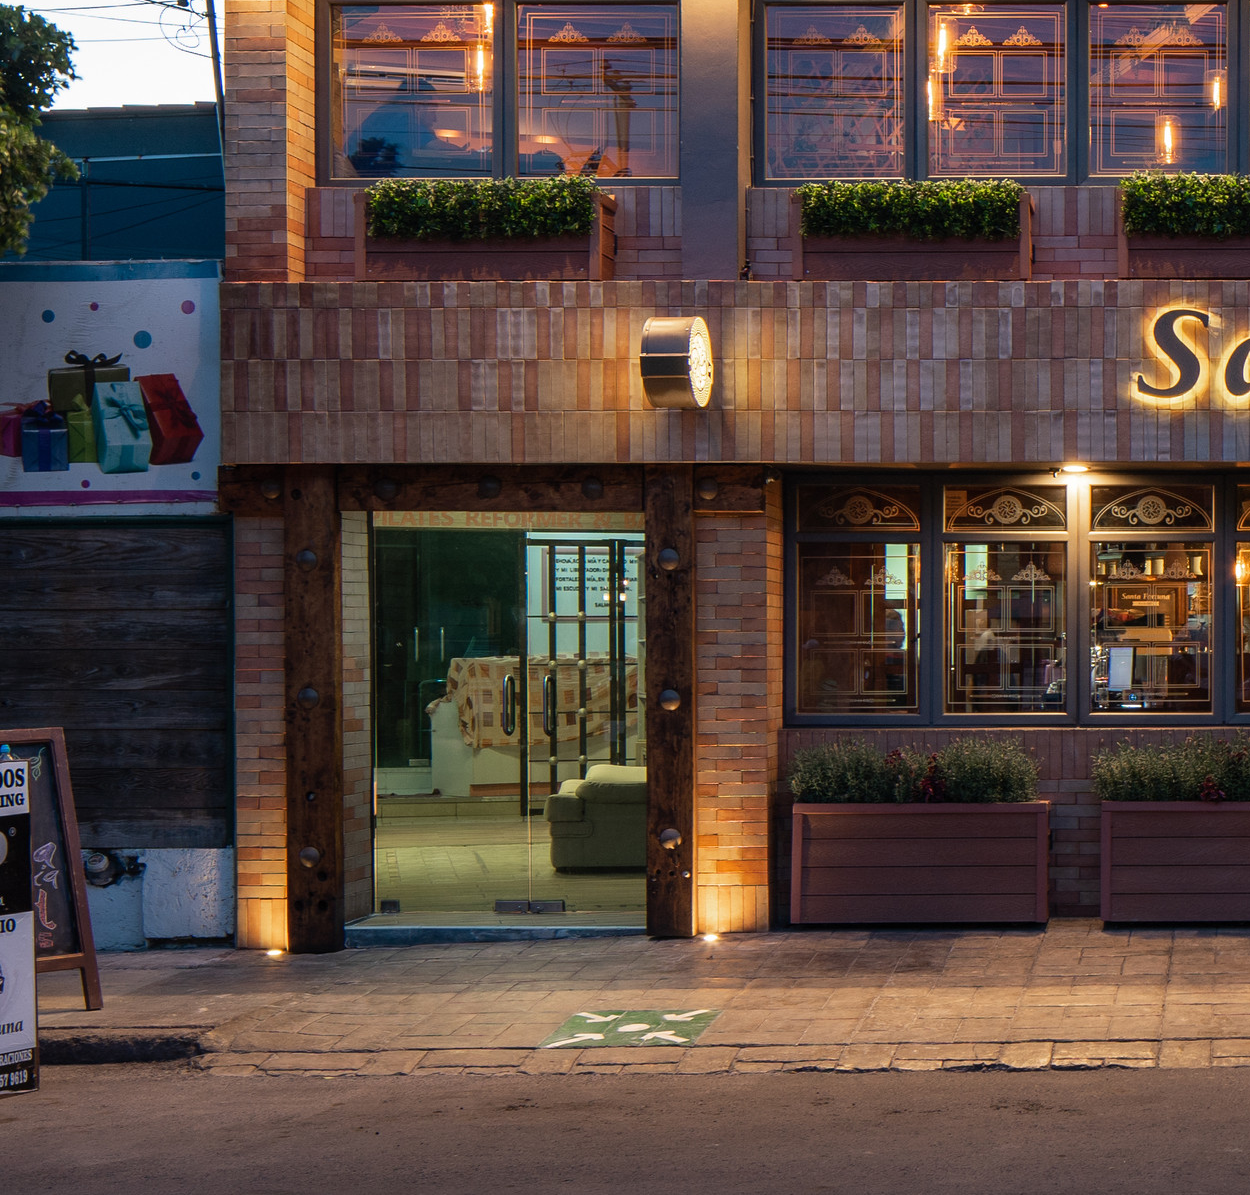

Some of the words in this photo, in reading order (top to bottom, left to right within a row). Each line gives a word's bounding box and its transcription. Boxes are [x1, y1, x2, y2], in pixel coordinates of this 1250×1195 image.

[466, 512, 582, 527] REFORMER
[0, 768, 25, 789] OS
[10, 1069, 28, 1086] 9619
